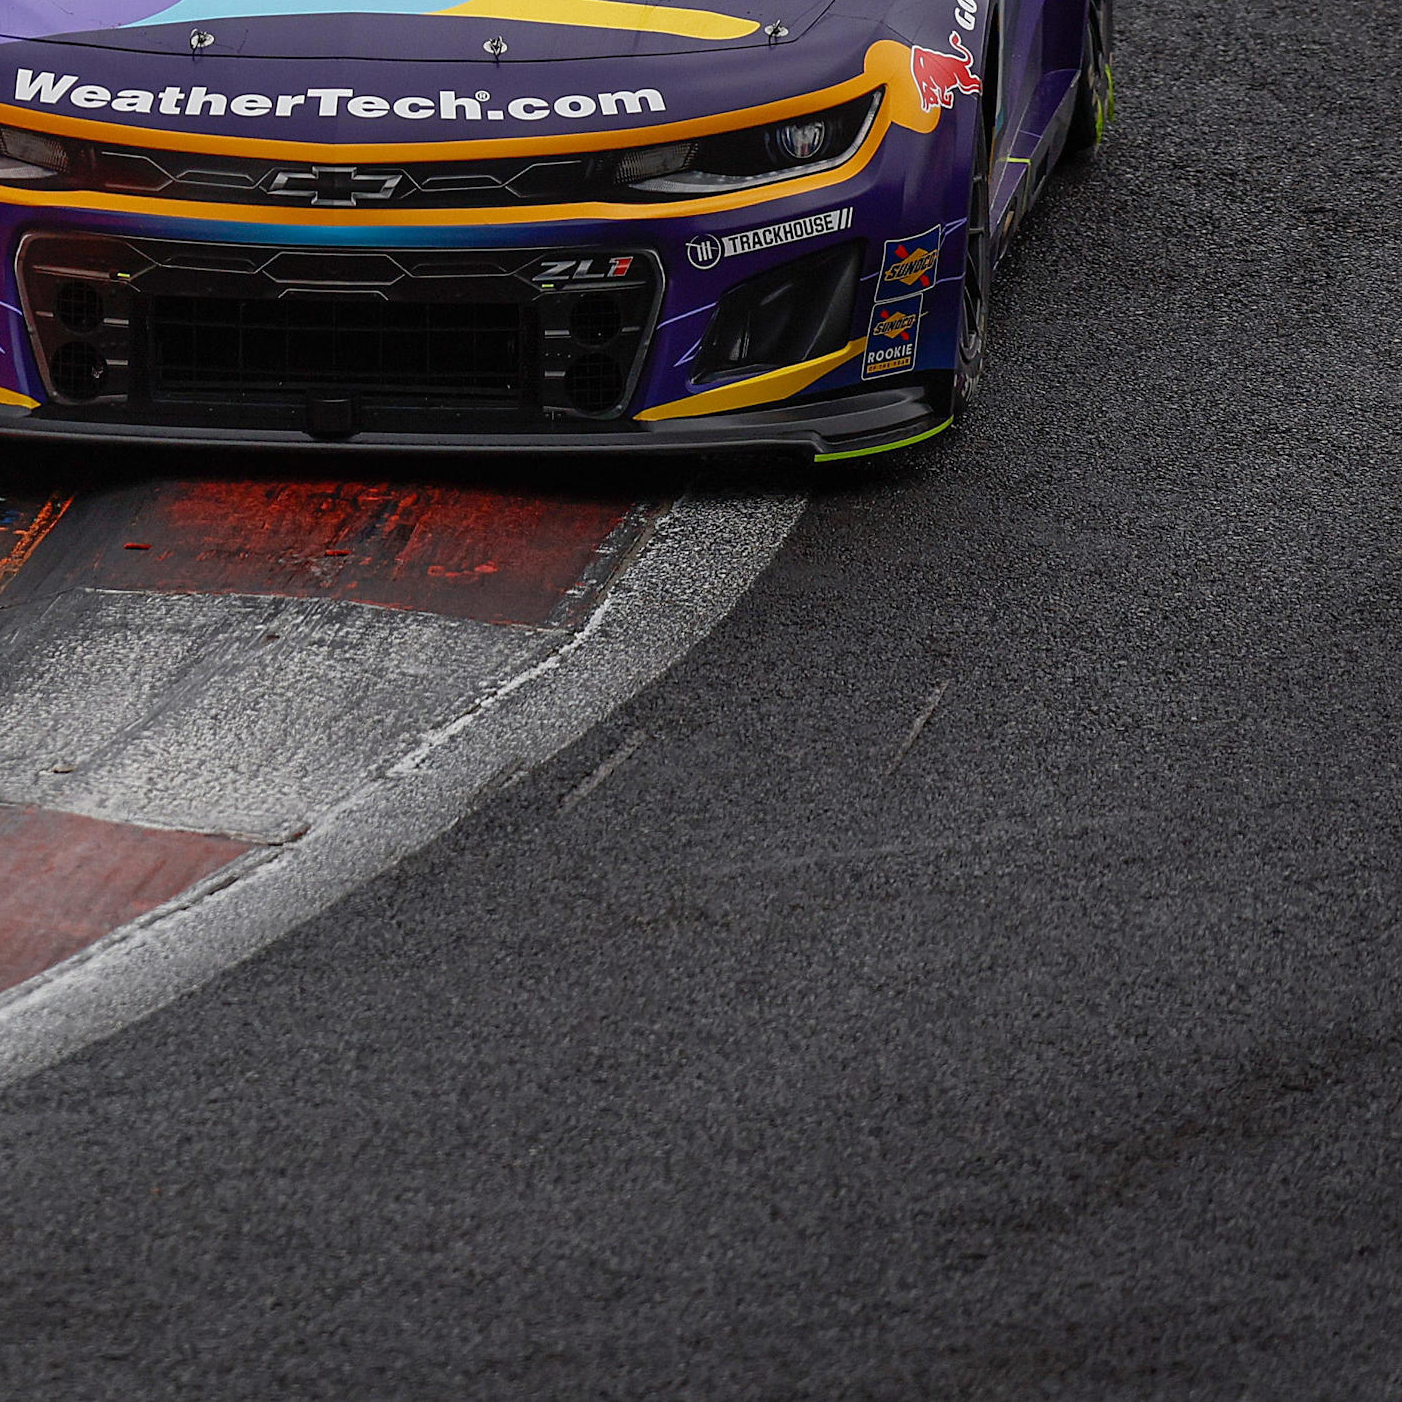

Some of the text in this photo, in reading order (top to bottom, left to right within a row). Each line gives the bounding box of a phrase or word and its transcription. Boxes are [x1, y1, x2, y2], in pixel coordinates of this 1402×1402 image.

[728, 213, 835, 254] TRACKHOUSE
[531, 255, 634, 282] ZL1
[886, 251, 938, 281] SUNOCO
[875, 315, 916, 335] SUNOCO
[867, 343, 913, 364] ROOKIE
[879, 361, 891, 370] THE
[893, 357, 910, 367] YEAR
